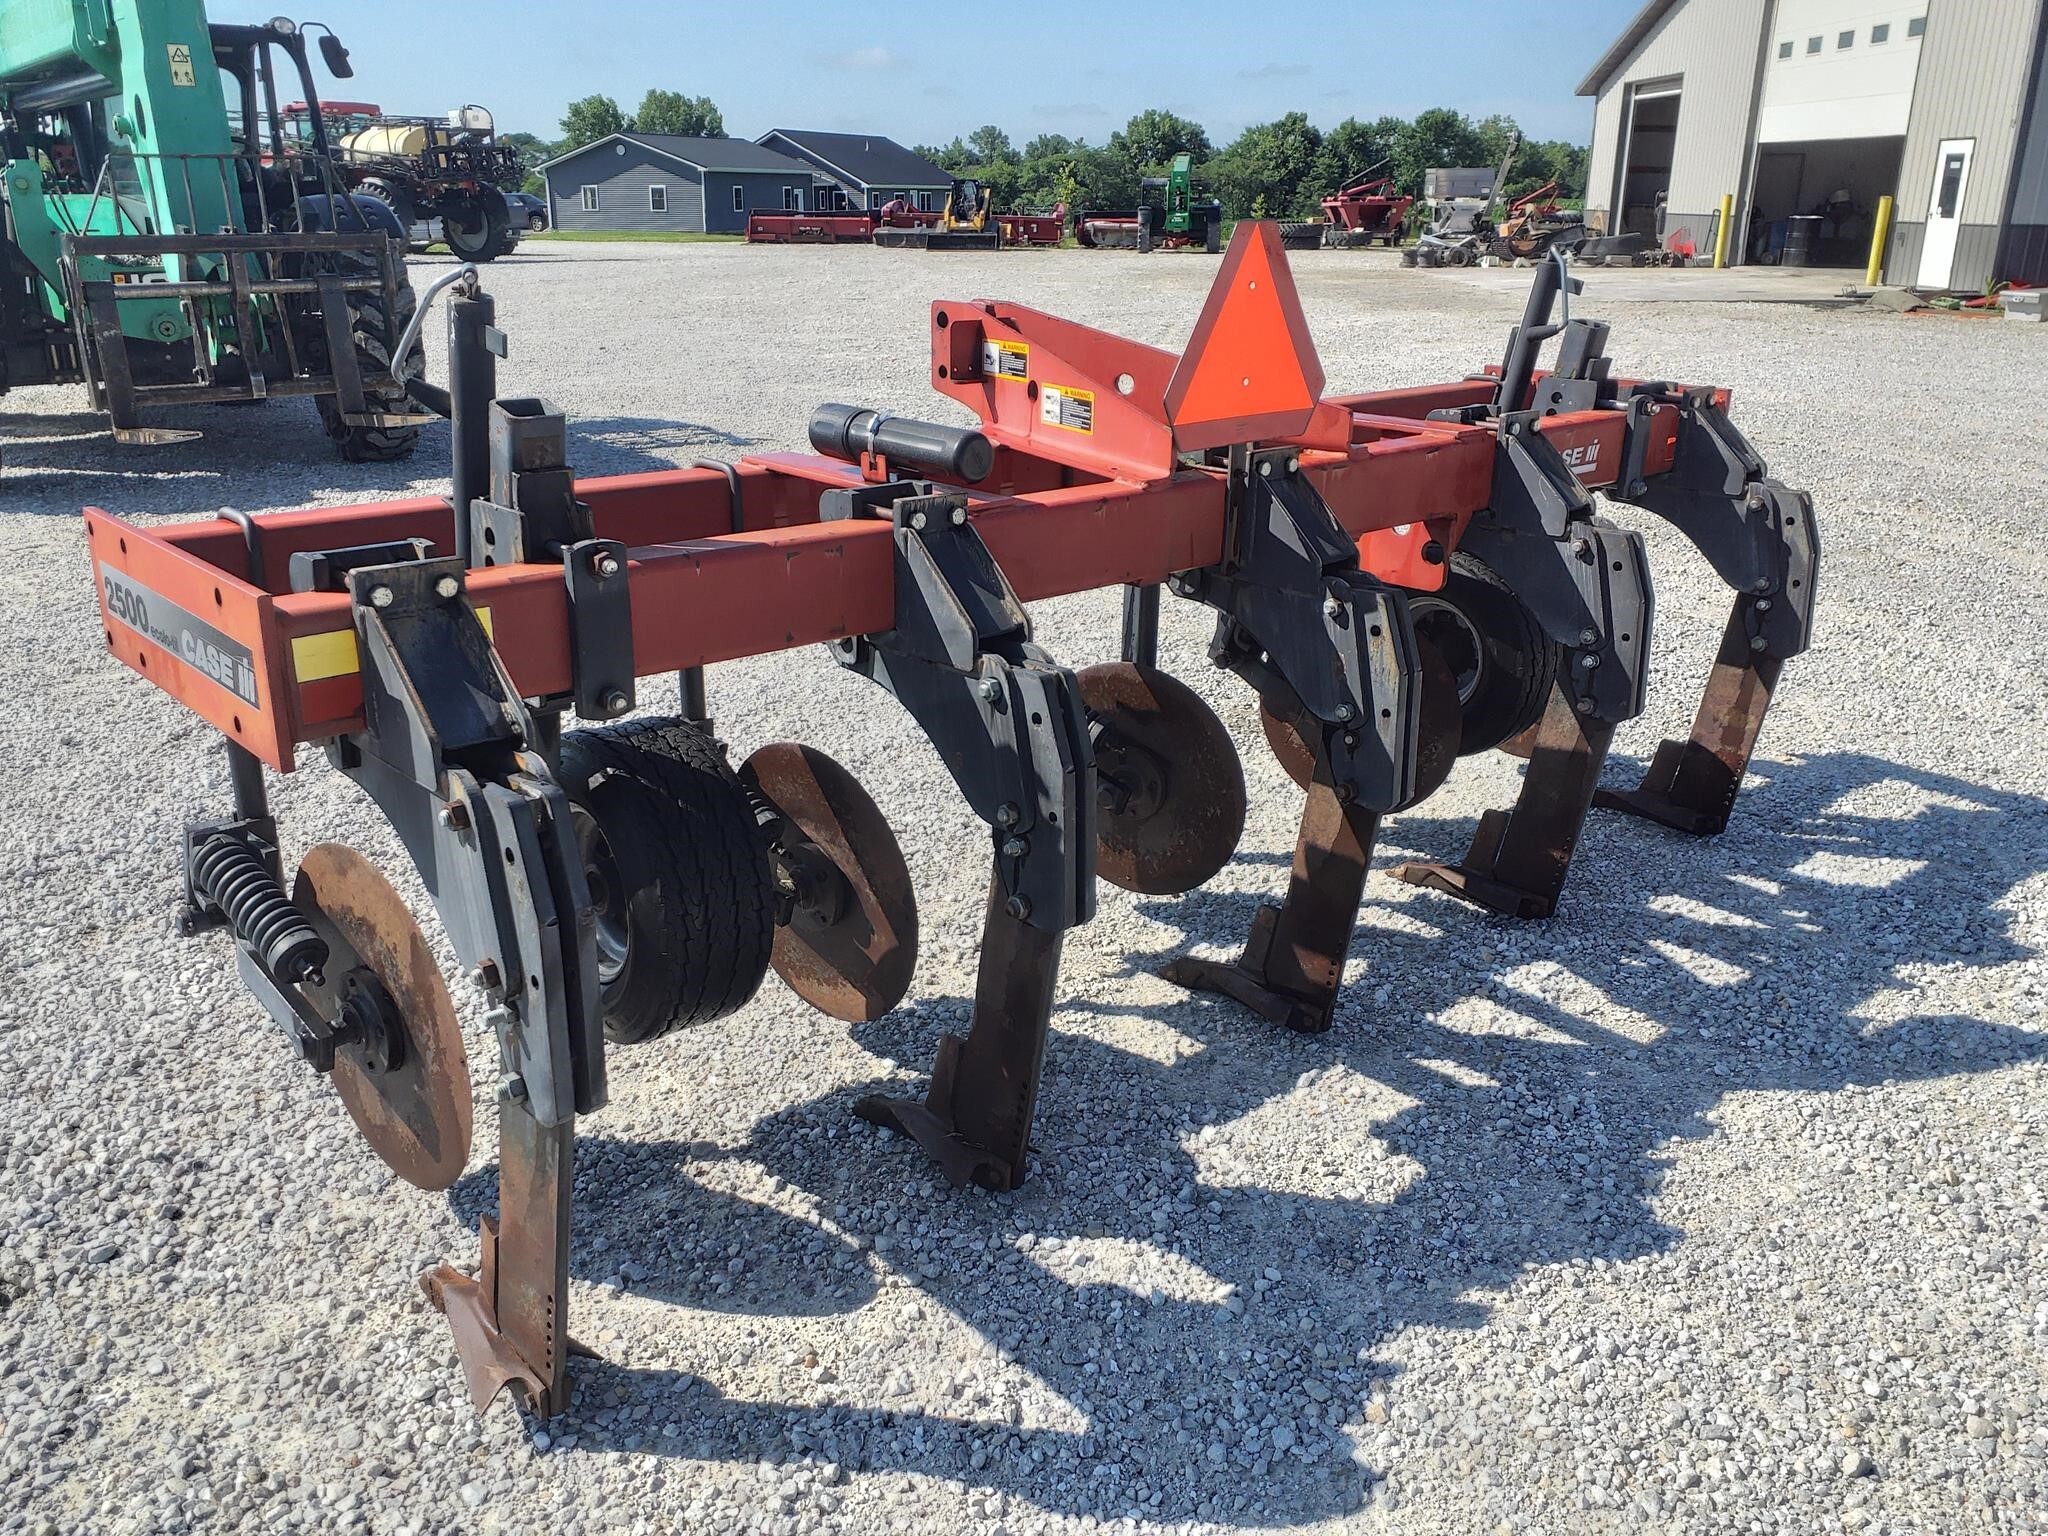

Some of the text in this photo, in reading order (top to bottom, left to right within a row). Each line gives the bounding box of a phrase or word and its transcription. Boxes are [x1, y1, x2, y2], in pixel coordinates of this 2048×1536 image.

[1561, 446, 1585, 466] SE
[104, 575, 150, 633] 2500
[181, 628, 235, 690] CASE
